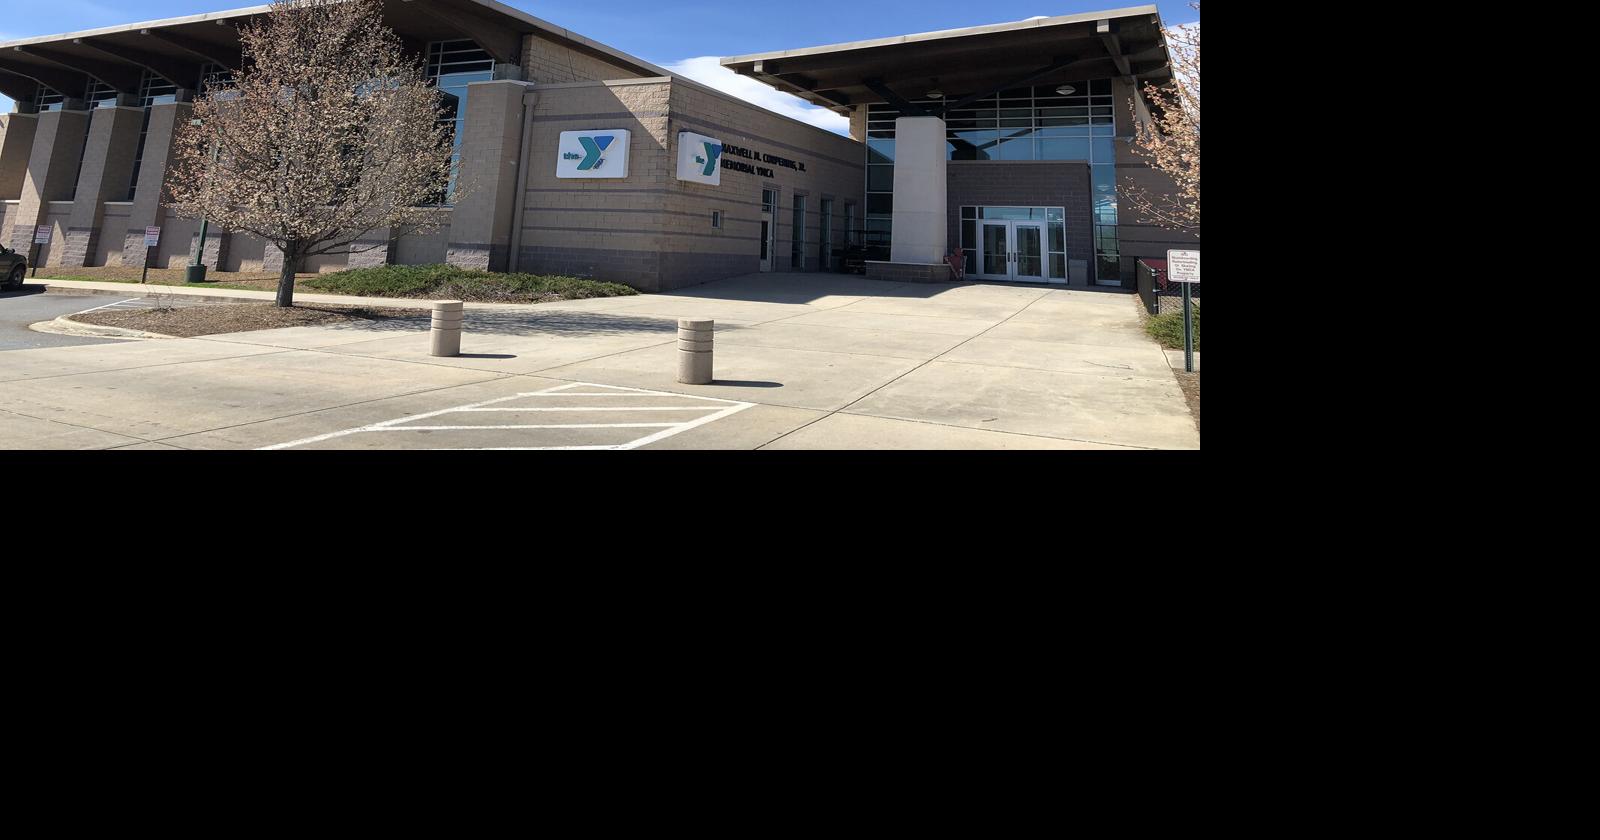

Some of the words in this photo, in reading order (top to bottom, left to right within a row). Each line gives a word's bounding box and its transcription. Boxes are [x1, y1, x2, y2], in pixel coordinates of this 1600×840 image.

[721, 143, 752, 160] MAXWELL
[720, 158, 755, 175] MEMORIAL
[756, 166, 774, 178] YMCA
